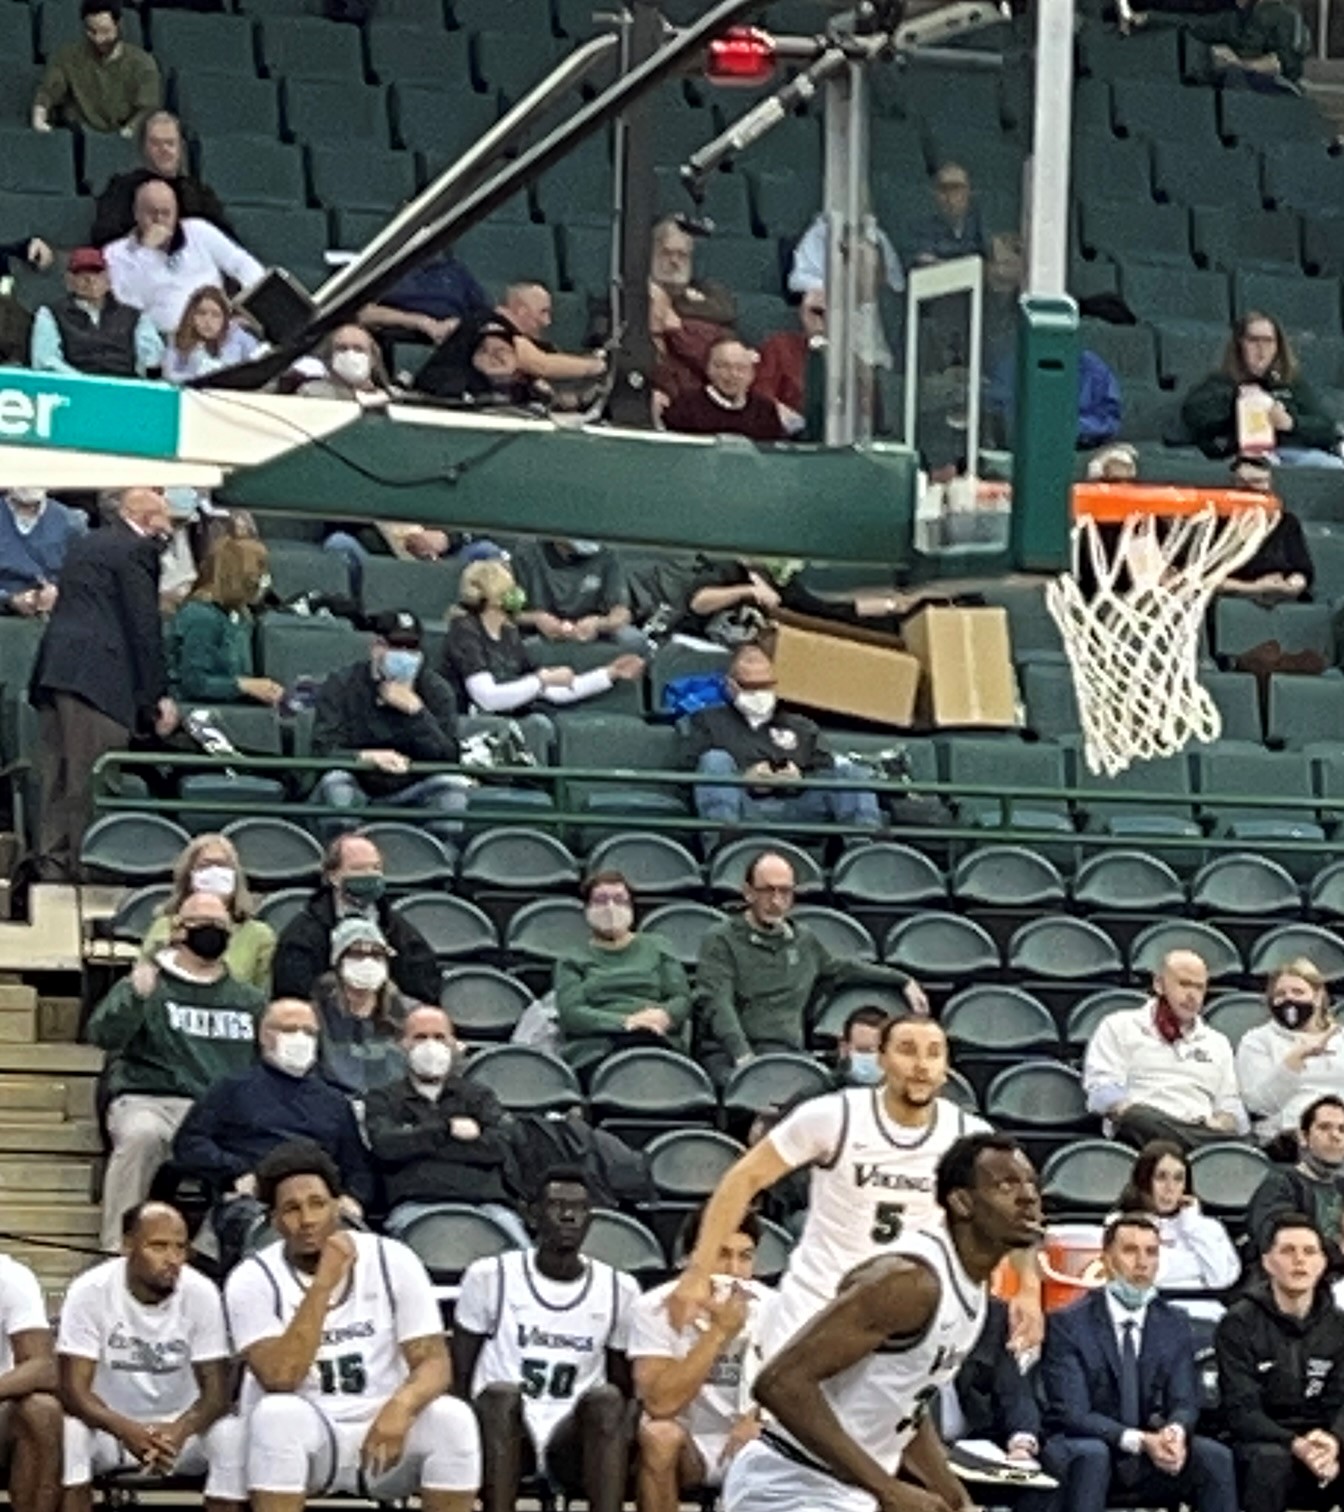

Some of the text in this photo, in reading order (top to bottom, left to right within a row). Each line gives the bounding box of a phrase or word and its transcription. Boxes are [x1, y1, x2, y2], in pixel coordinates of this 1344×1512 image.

[853, 1163, 932, 1192] VIKING
[871, 1201, 906, 1245] 5
[316, 1352, 367, 1395] 15
[519, 1357, 578, 1400] 50
